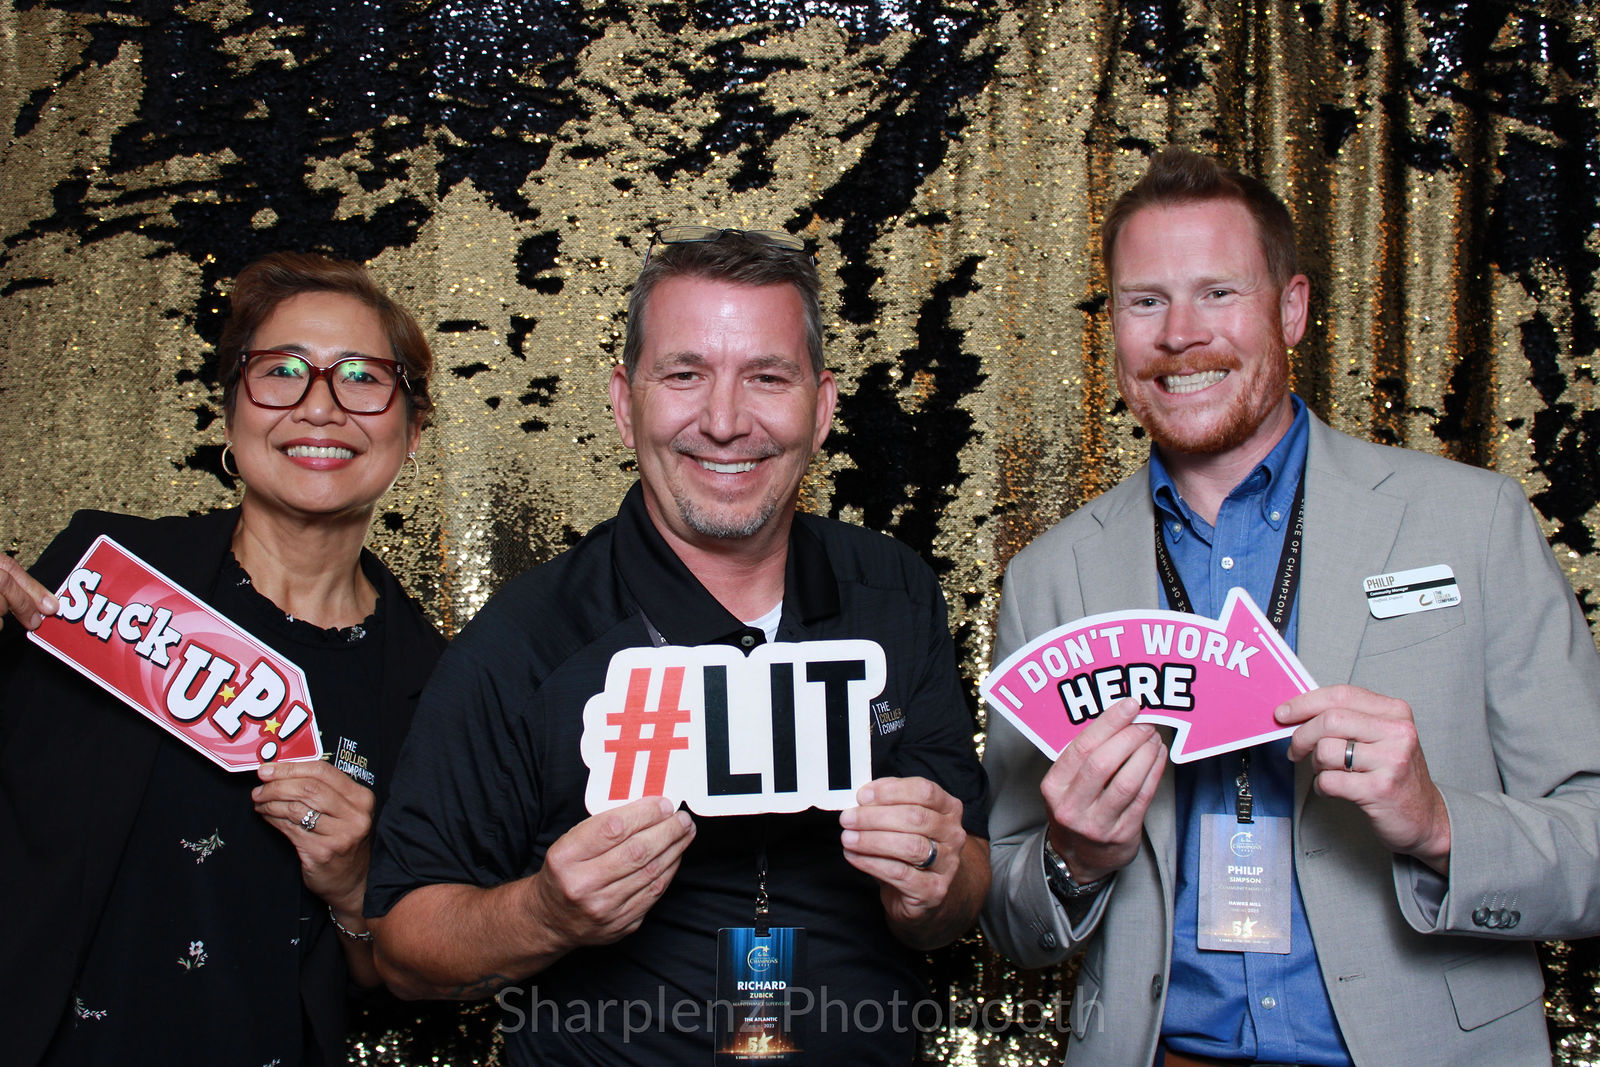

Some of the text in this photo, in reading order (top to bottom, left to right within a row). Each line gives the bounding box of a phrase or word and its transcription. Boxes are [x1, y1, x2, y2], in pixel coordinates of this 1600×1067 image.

[1291, 540, 1300, 554] OF
[1366, 575, 1395, 590] PHILIP
[1172, 586, 1181, 598] OF
[1273, 557, 1296, 624] CHAMPIONS
[998, 623, 1261, 711] I DON'T WORK
[1060, 663, 1196, 724] HERE
[875, 700, 891, 714] THE
[604, 659, 867, 801] #LIT
[343, 737, 359, 753] THE
[340, 748, 369, 770] COLLIER
[337, 759, 376, 786] COMPANIES
[1227, 865, 1264, 876] PHILIP
[1229, 876, 1262, 884] SIMPSON
[737, 981, 787, 991] RICHARD
